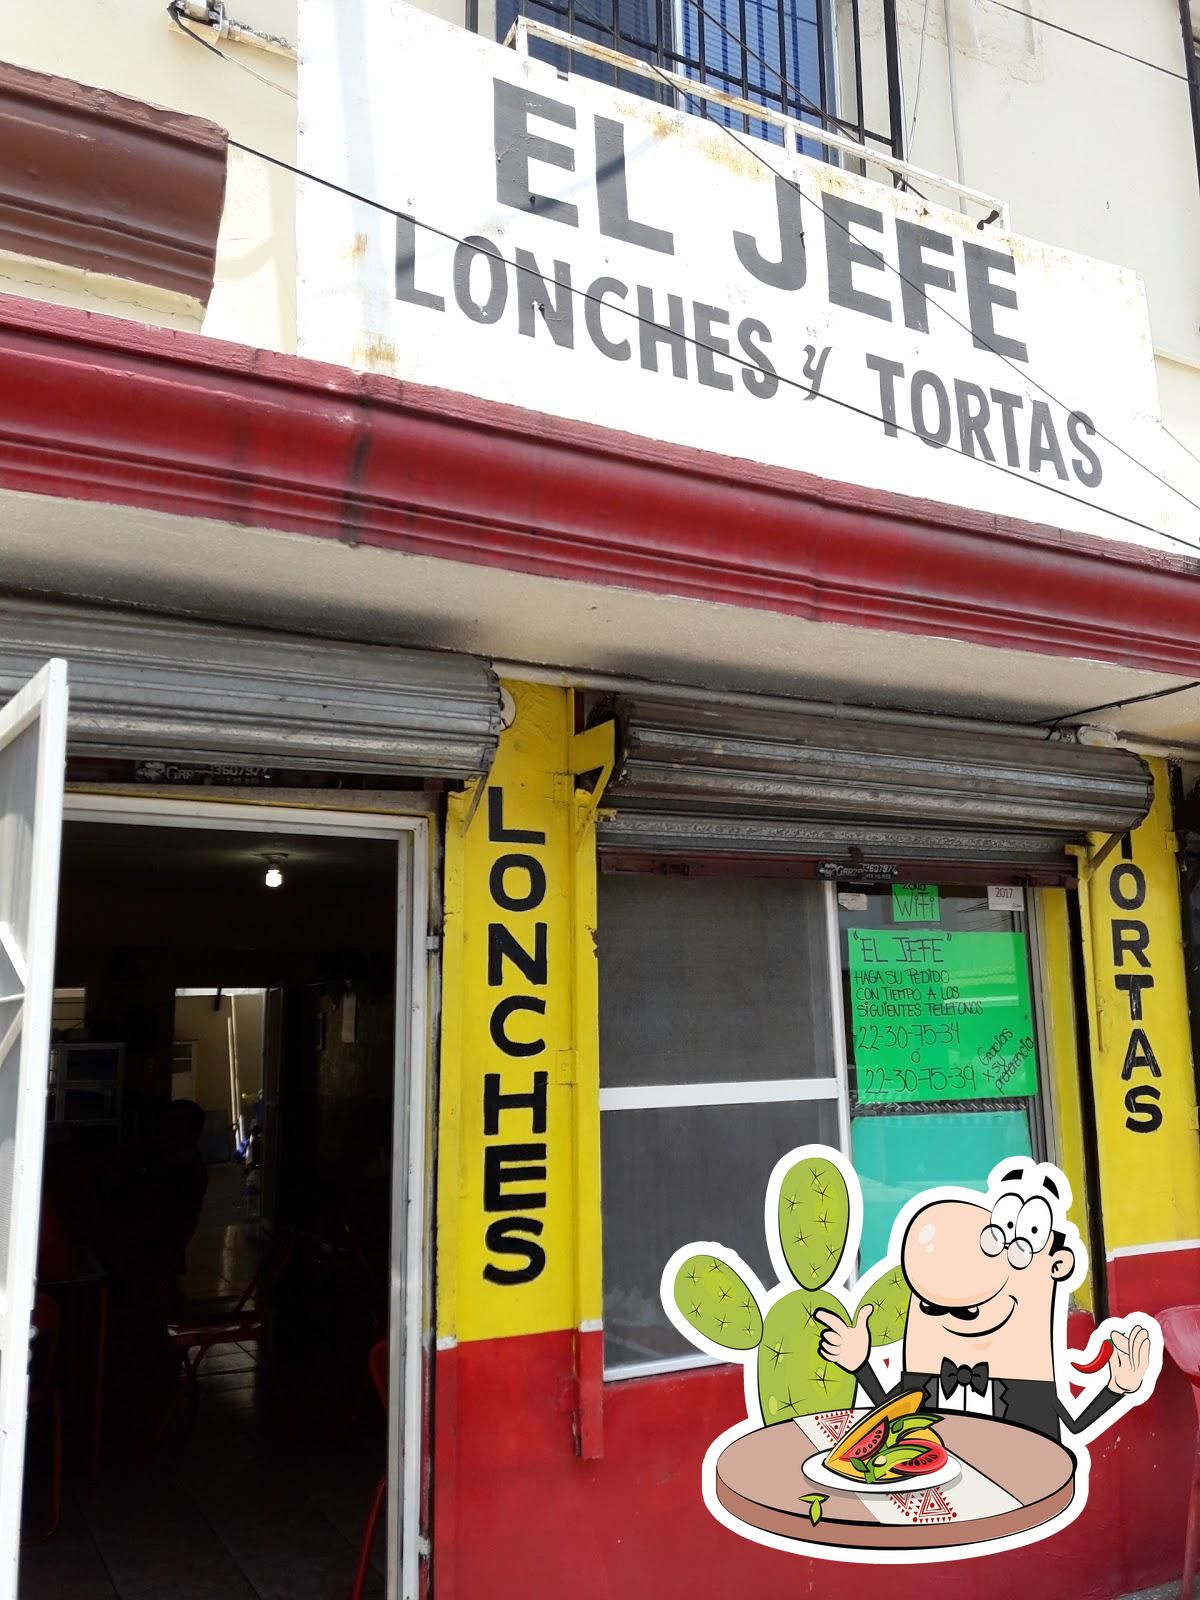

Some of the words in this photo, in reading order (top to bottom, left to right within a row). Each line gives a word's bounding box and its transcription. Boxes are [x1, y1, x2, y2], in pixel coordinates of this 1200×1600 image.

[493, 78, 674, 257] EL
[732, 172, 1029, 364] JEFE
[397, 213, 778, 401] LONCHES
[866, 354, 1103, 489] TORTAS
[995, 887, 1013, 899] 2017
[854, 970, 883, 985] HAGA
[885, 970, 903, 985] SU
[856, 987, 880, 1001] CON
[880, 986, 922, 1001] TIEMPO
[927, 986, 937, 1001] A
[941, 986, 960, 1001] LOS
[924, 1001, 984, 1016] TELEFONOS
[482, 786, 548, 1286] LONCHES
